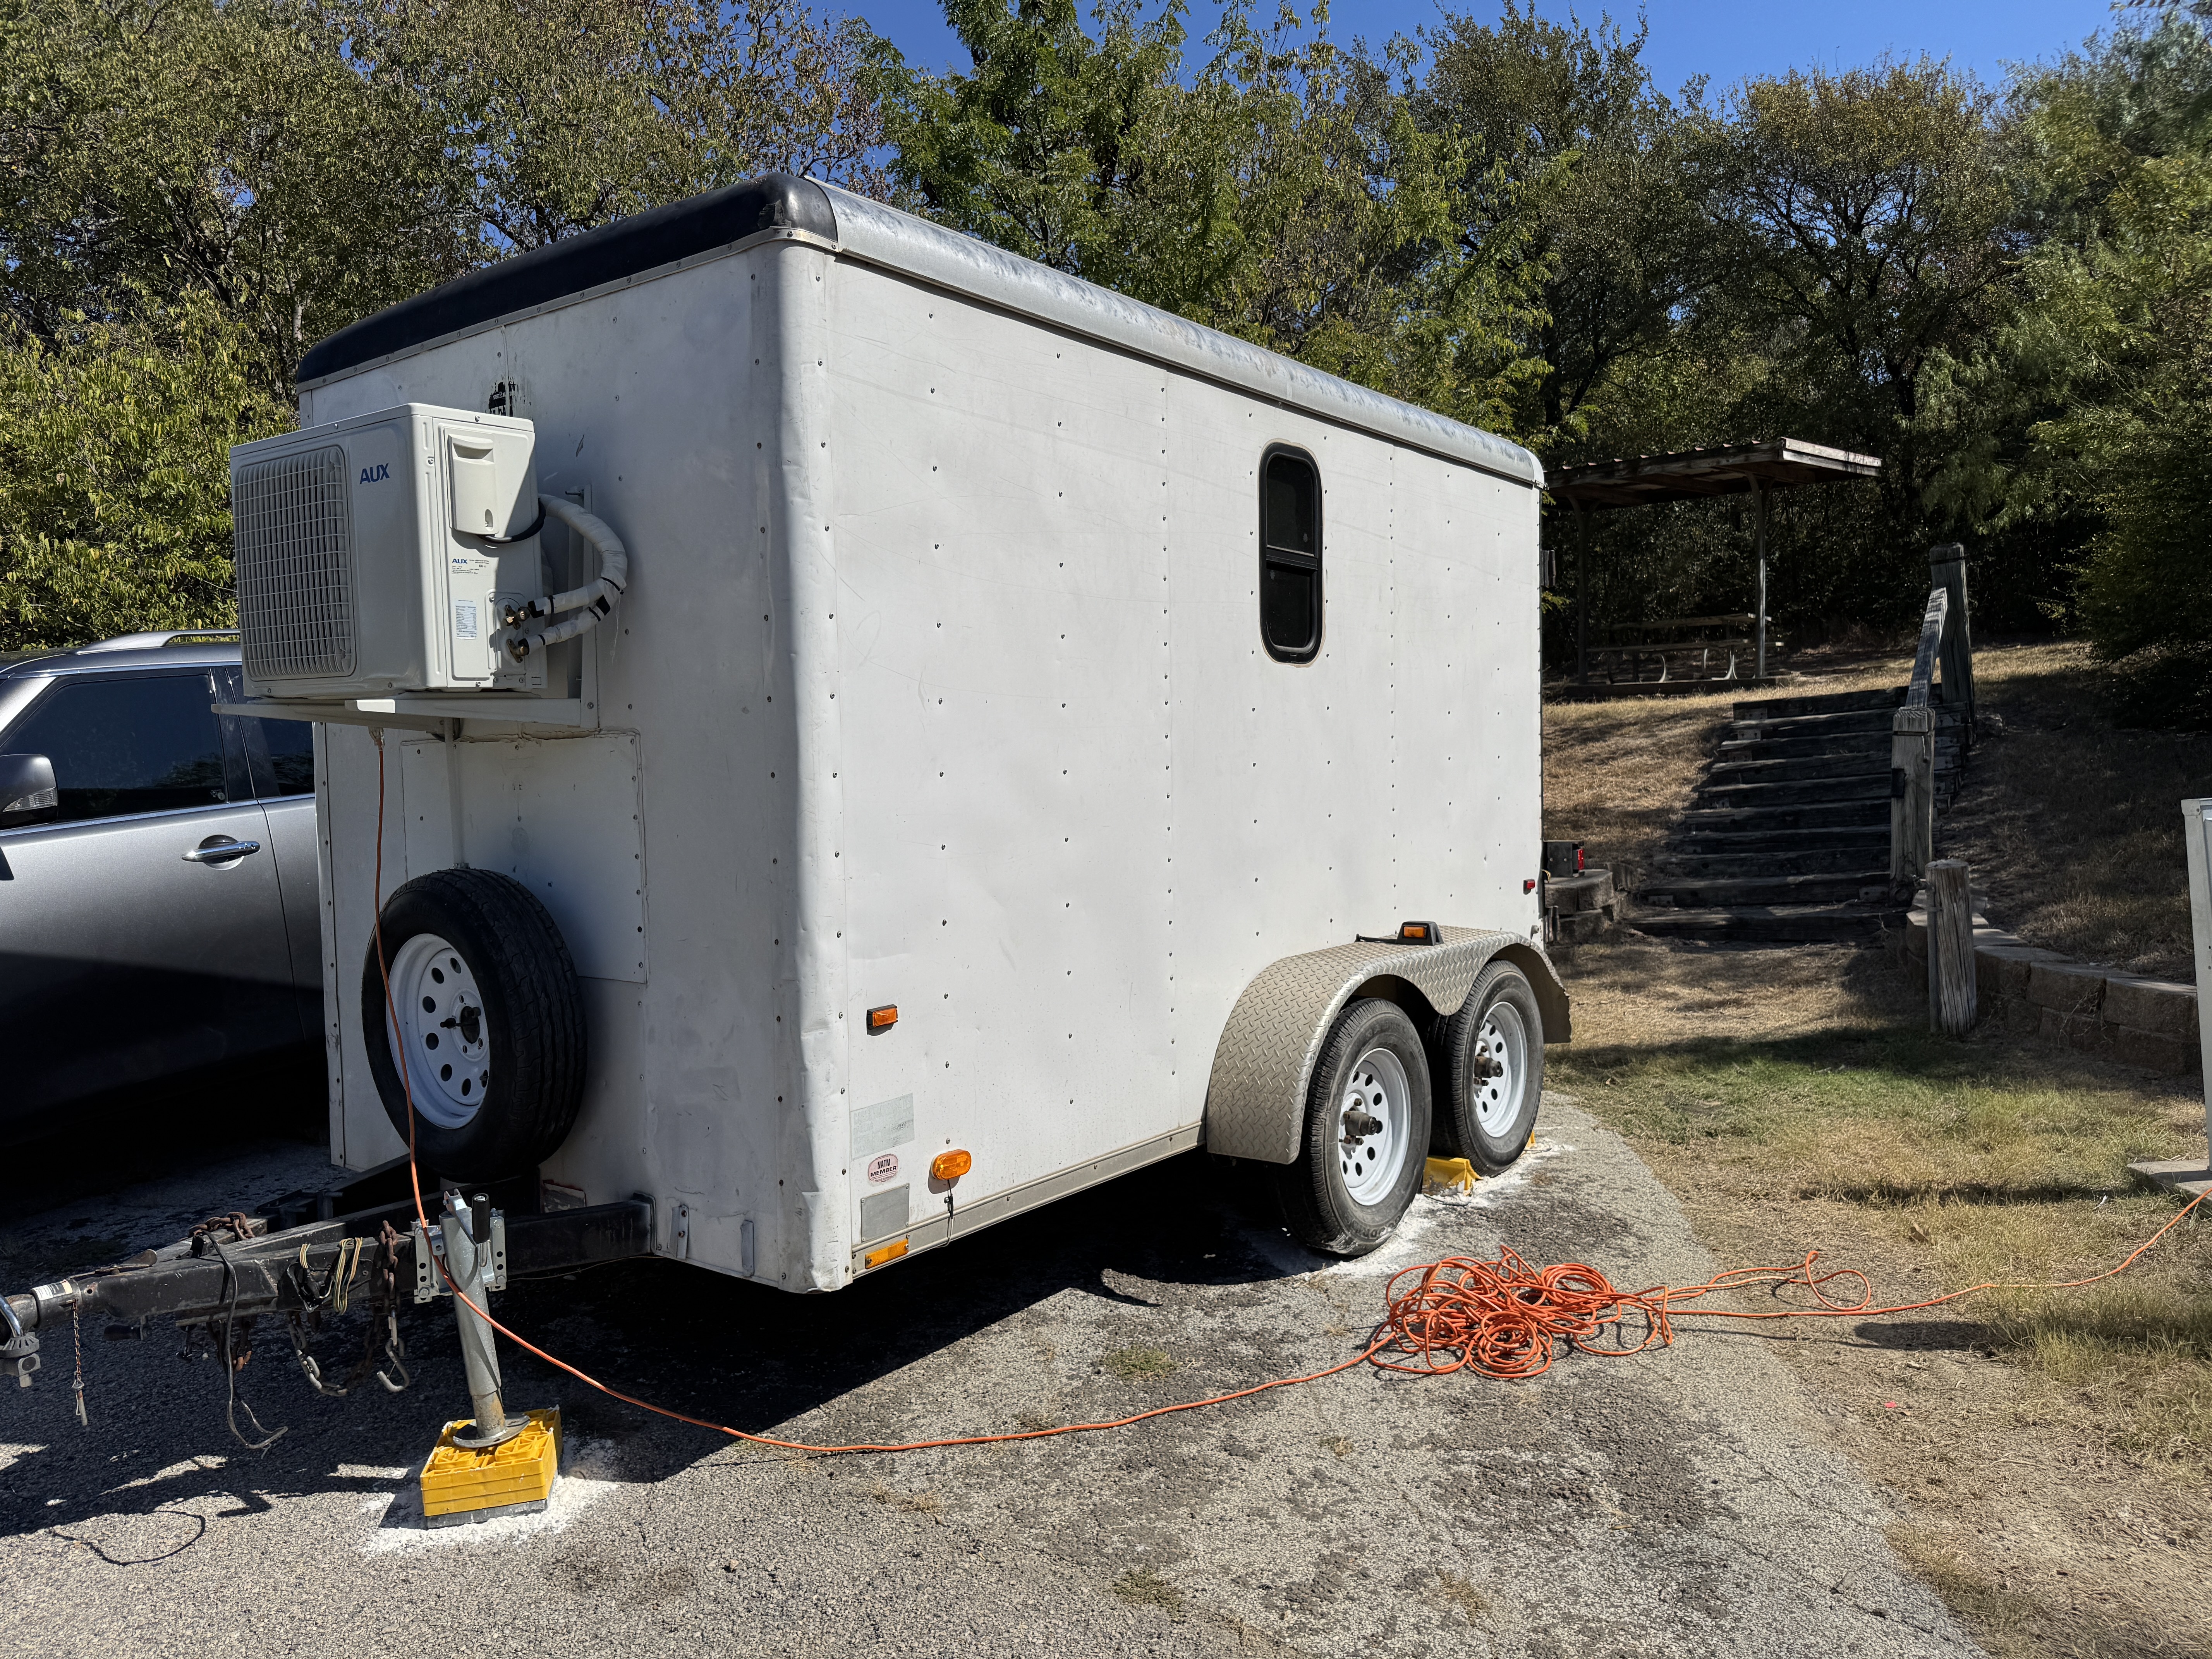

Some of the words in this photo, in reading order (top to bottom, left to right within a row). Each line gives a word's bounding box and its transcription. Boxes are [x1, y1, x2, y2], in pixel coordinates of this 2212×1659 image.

[360, 463, 390, 484] AUX
[877, 1158, 891, 1169] NATM
[870, 1166, 897, 1177] MEMBER
